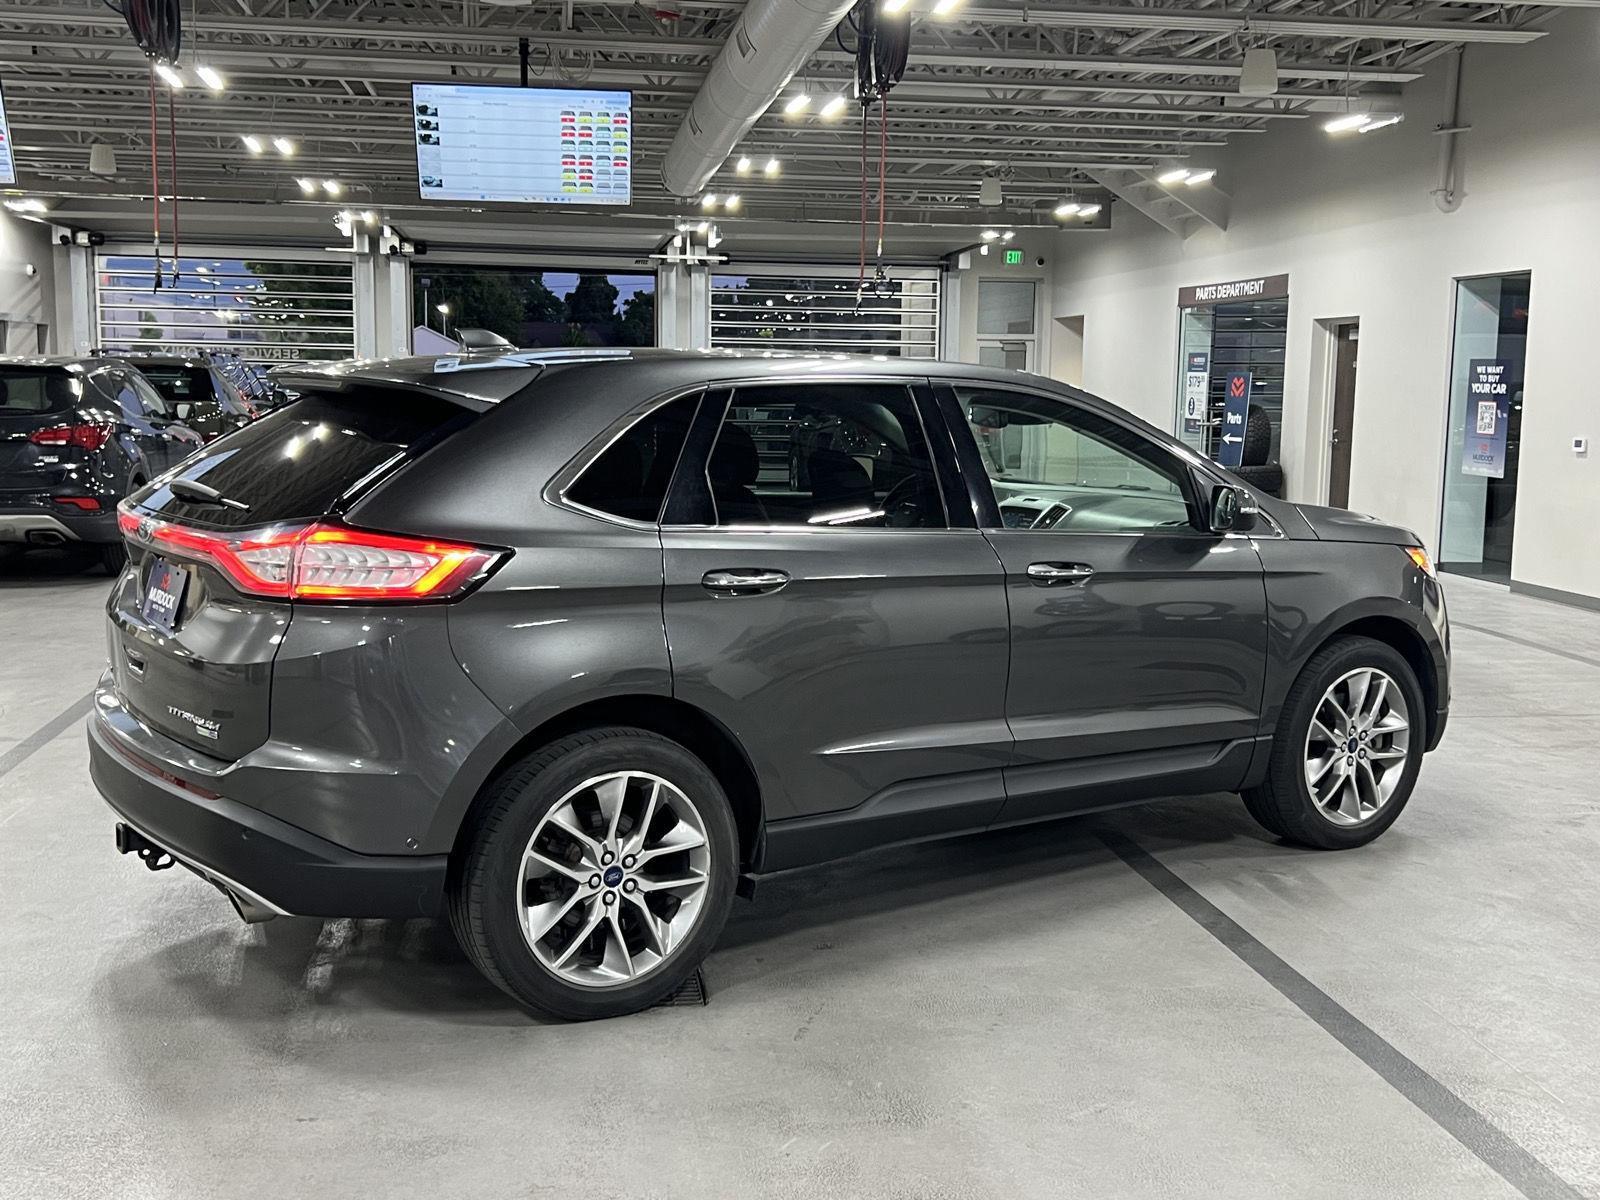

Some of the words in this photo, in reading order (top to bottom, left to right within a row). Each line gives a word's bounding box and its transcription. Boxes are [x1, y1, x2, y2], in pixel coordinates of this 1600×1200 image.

[1006, 250, 1022, 264] EXIT
[1195, 286, 1217, 301] PARTS
[1217, 280, 1265, 299] DEPARTMENT
[1476, 365, 1487, 374] WE
[1487, 365, 1504, 374] WANT
[1479, 374, 1488, 383] TO
[1488, 374, 1500, 383] BUY
[1471, 382, 1491, 394] YOUR
[1490, 383, 1507, 395] CAR
[1226, 411, 1243, 425] Parts
[148, 586, 176, 610] MURDOCK
